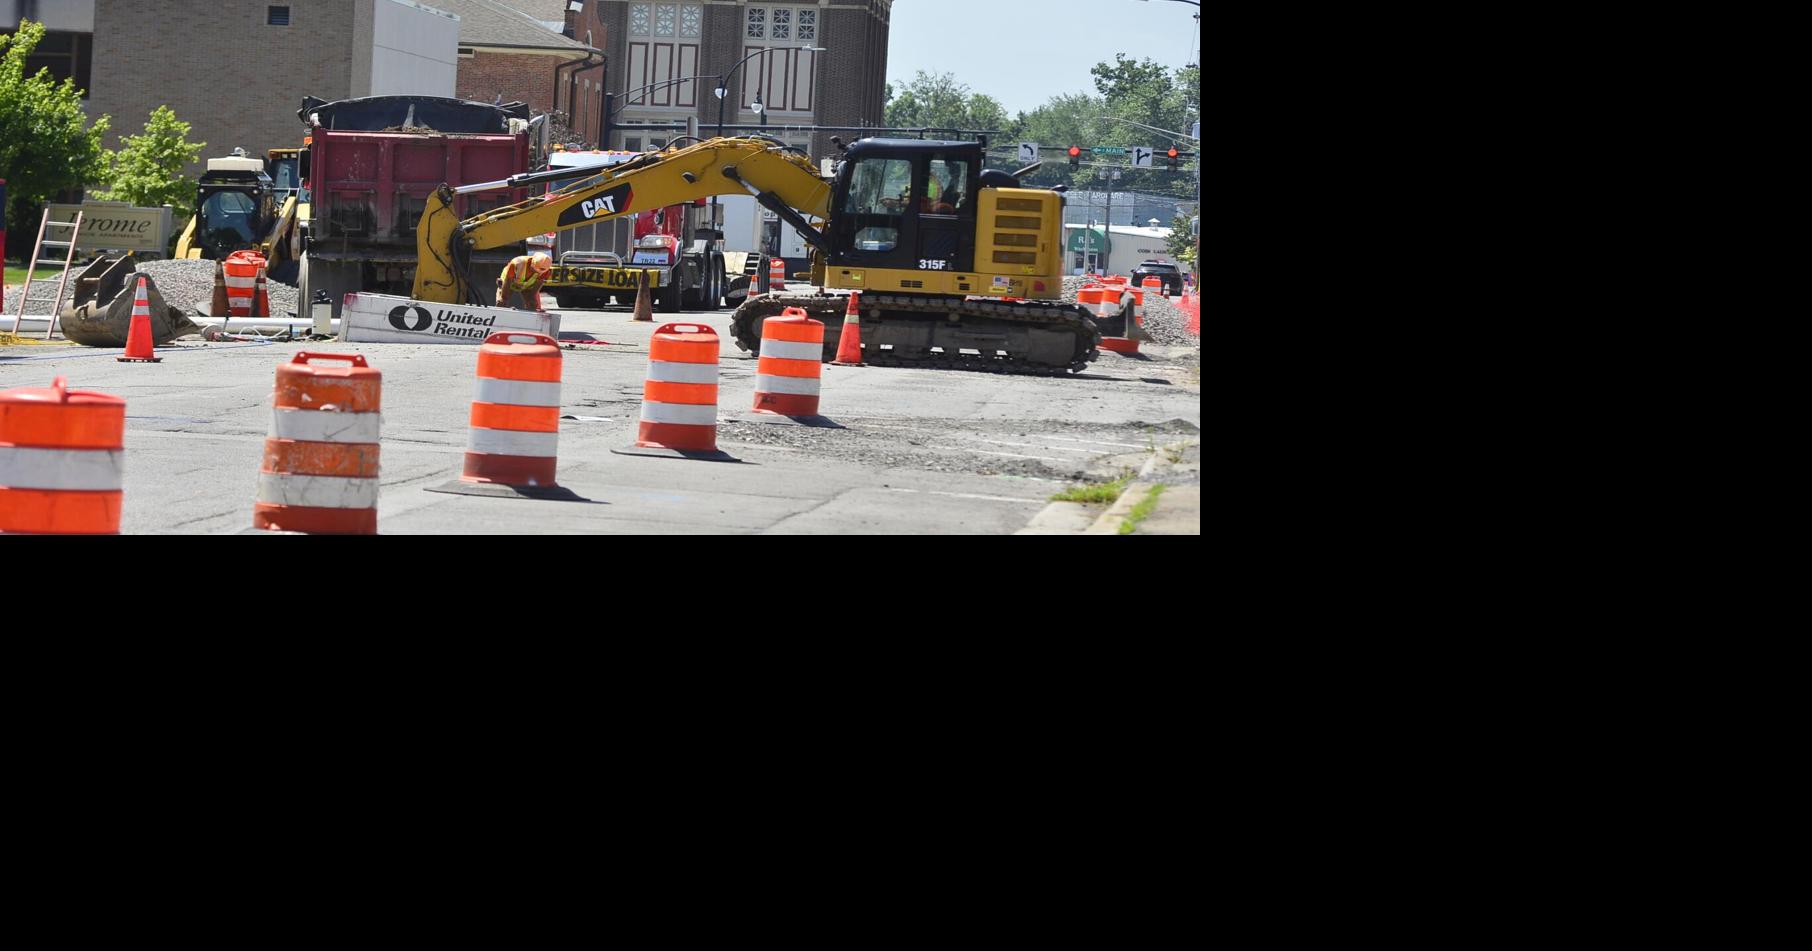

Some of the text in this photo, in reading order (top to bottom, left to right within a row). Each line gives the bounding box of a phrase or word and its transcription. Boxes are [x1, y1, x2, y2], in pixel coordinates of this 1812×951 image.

[581, 195, 615, 219] CAT
[59, 211, 152, 233] Jerome
[919, 259, 946, 270] 315F
[551, 268, 604, 283] ERSIZE
[437, 310, 496, 327] United
[434, 322, 496, 339] Rental
